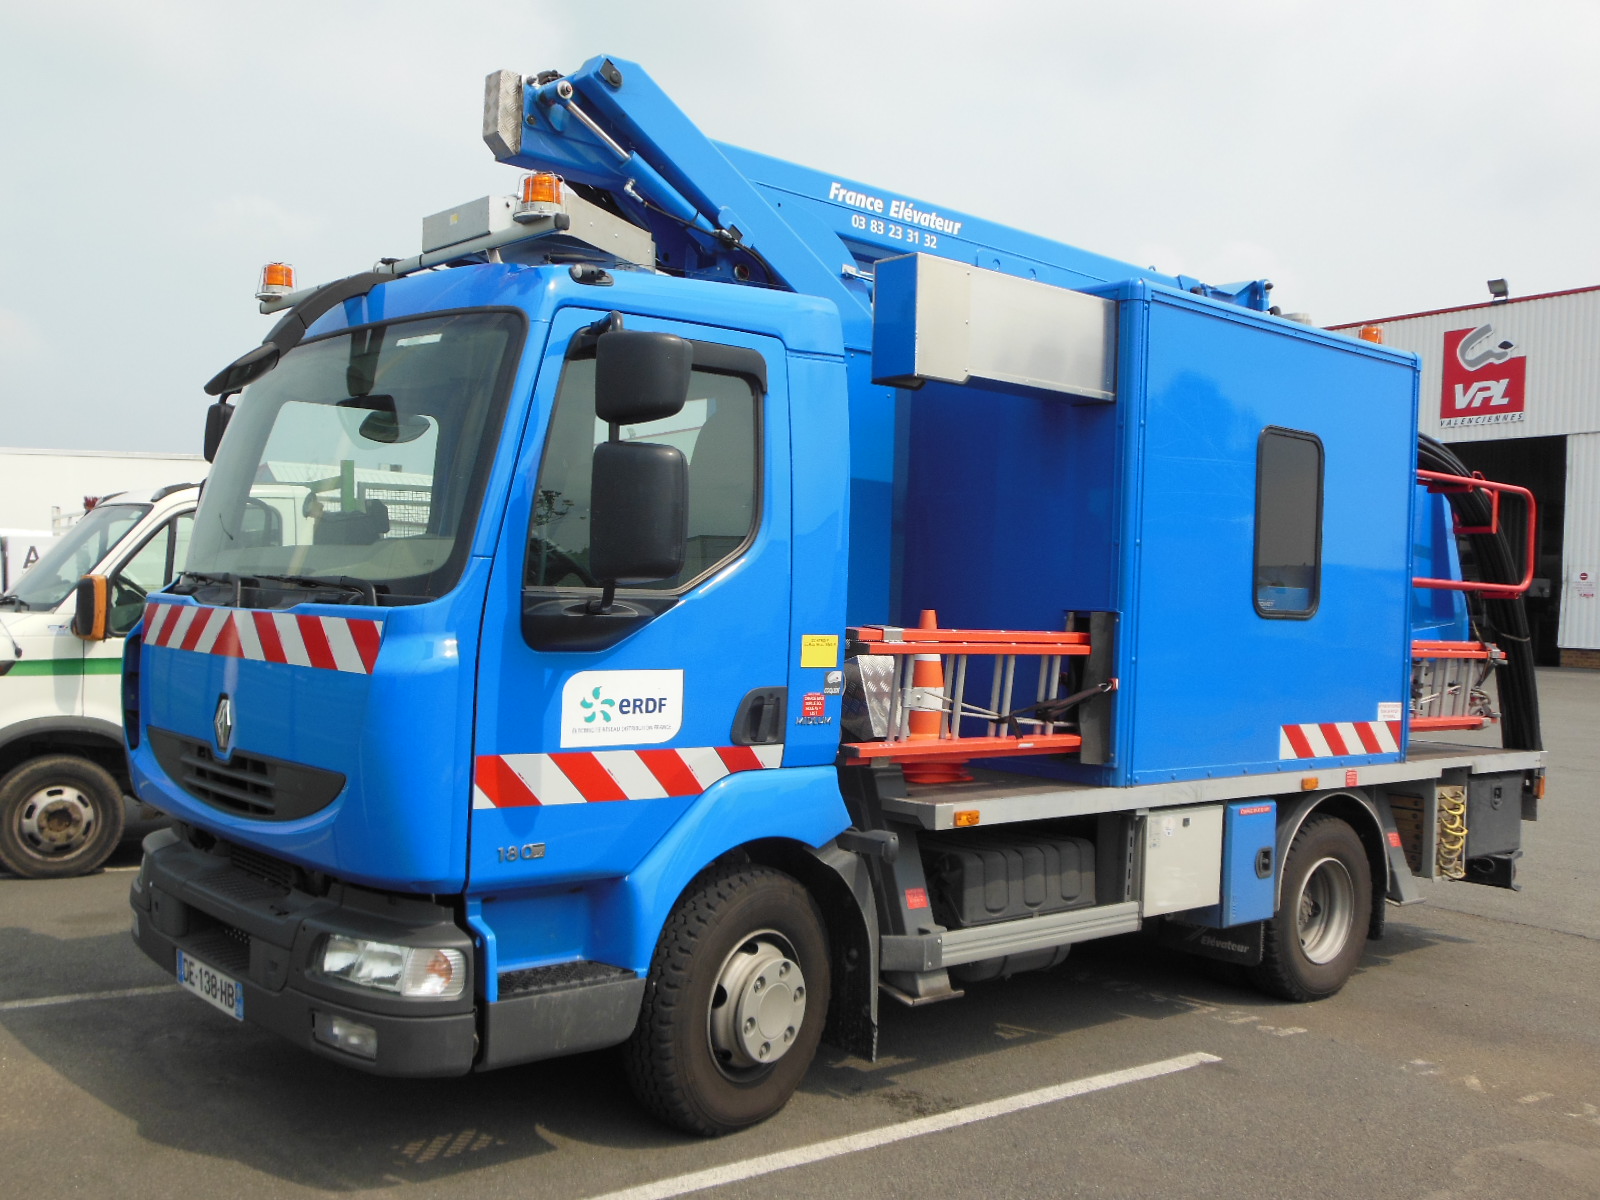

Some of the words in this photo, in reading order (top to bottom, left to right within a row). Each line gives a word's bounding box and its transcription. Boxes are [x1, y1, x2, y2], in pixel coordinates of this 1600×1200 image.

[829, 182, 884, 213] France
[889, 200, 962, 235] Elévateur
[851, 214, 866, 229] 03
[870, 220, 884, 234] 83
[888, 225, 903, 239] 23
[906, 229, 919, 244] 31
[924, 234, 937, 248] 32
[1455, 378, 1510, 410] VPL
[1440, 412, 1524, 427] VALENCIENNES
